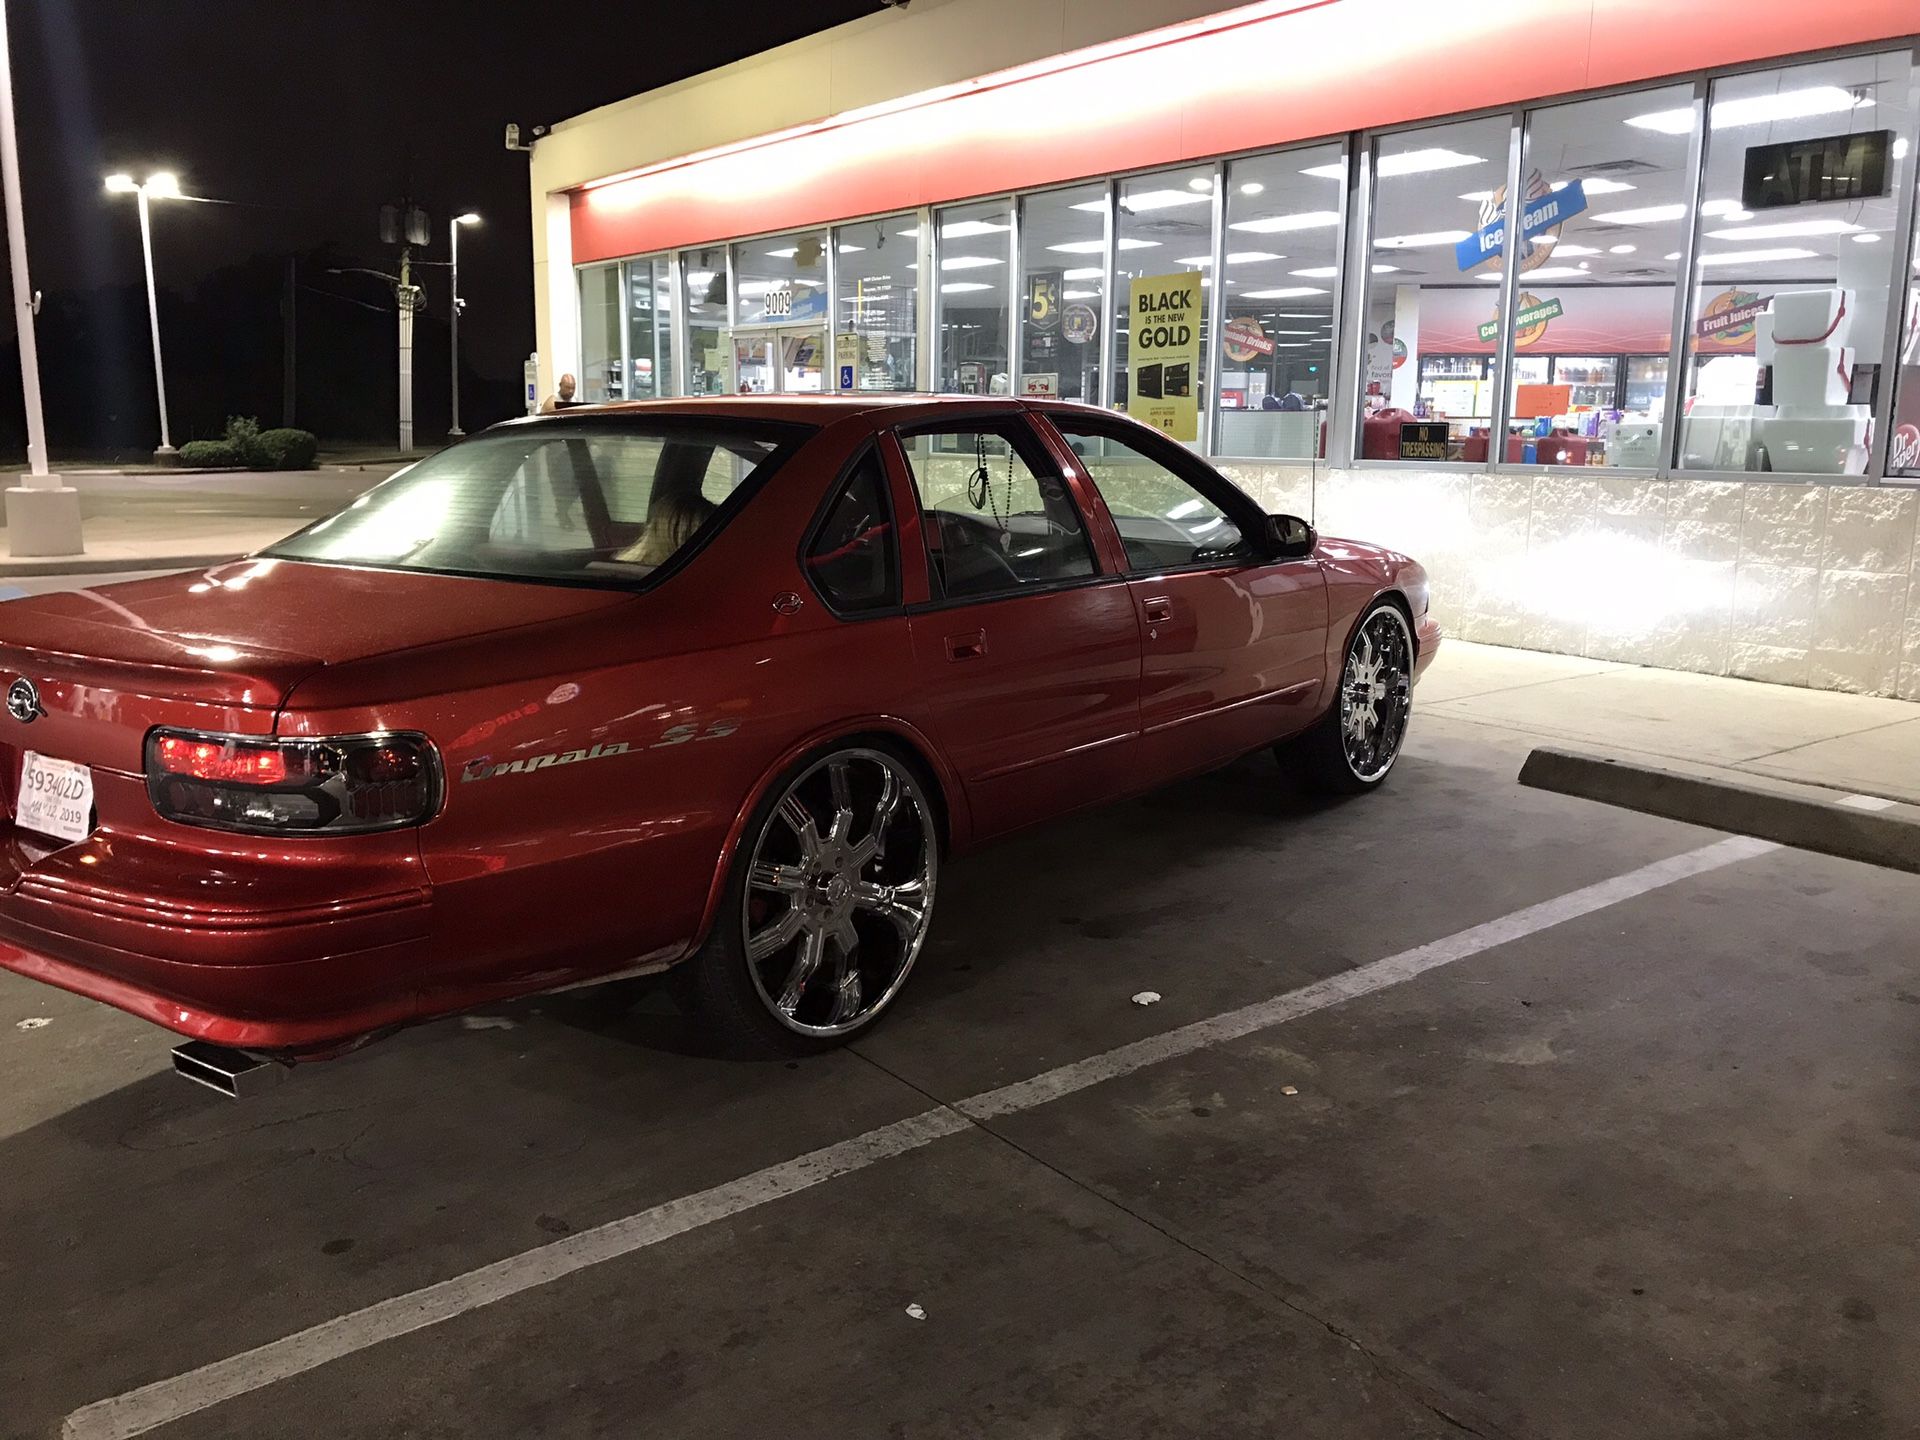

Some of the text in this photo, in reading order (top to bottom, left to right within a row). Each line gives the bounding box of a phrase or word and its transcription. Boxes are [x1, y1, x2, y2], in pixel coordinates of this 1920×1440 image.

[1757, 137, 1866, 205] ATM
[1479, 201, 1559, 253] Ice eam
[765, 292, 791, 315] 9009
[1139, 289, 1192, 313] BLACK
[1145, 312, 1185, 325] IS THE NEW
[1481, 304, 1559, 338] Col verages
[1703, 304, 1765, 332] Fruit Juices
[1138, 326, 1191, 349] GOLD
[1246, 335, 1273, 351] Drinks
[1418, 425, 1429, 439] NO
[1401, 441, 1446, 458] TRESPASSING
[1893, 432, 1909, 459] Dr
[460, 742, 643, 784] Impala
[28, 769, 84, 801] 593402D
[31, 800, 48, 813] MAY
[59, 807, 83, 824] 2019
